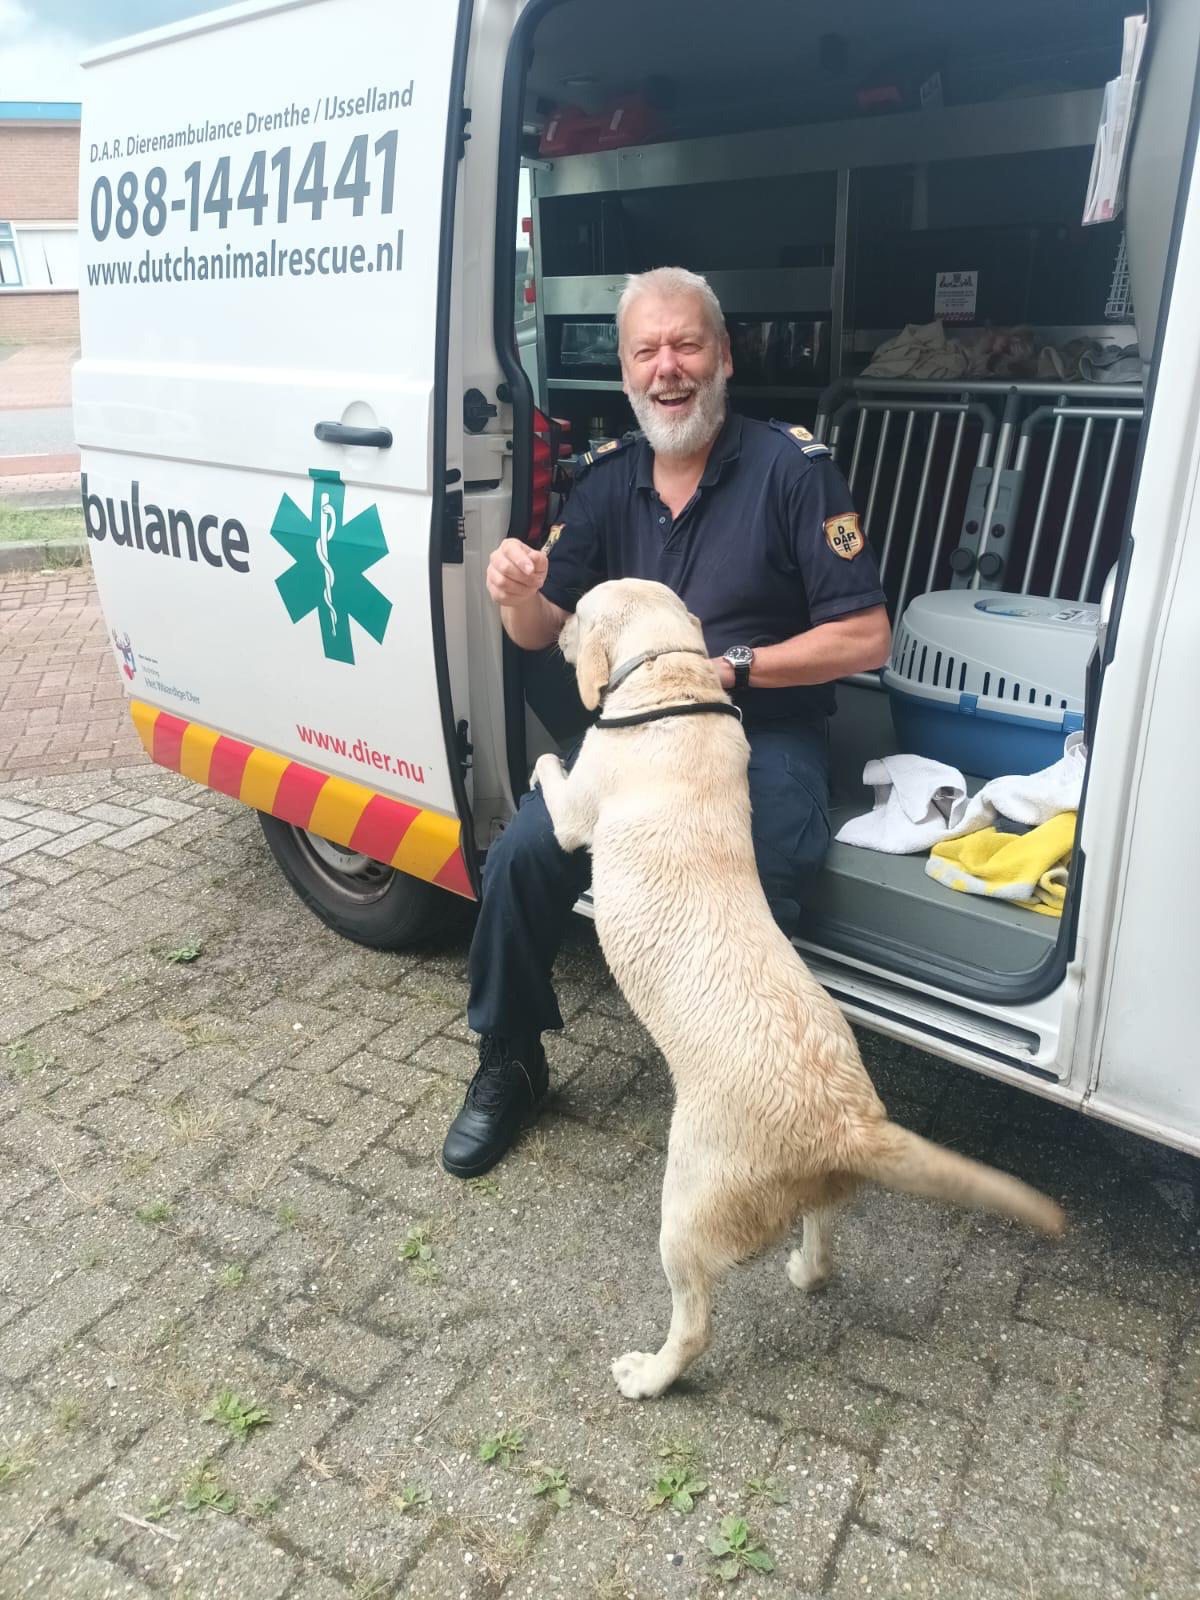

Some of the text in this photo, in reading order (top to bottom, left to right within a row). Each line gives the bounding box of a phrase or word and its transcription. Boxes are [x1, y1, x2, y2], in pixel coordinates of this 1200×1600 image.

[90, 80, 414, 163] D.A.R. Dierenambulance Drenthe / IJsselland
[90, 129, 399, 242] 088-1441441
[87, 229, 404, 286] www.dutchanimalrescue.nl
[81, 473, 250, 573] bulance
[296, 724, 425, 783] www.dier.nu
